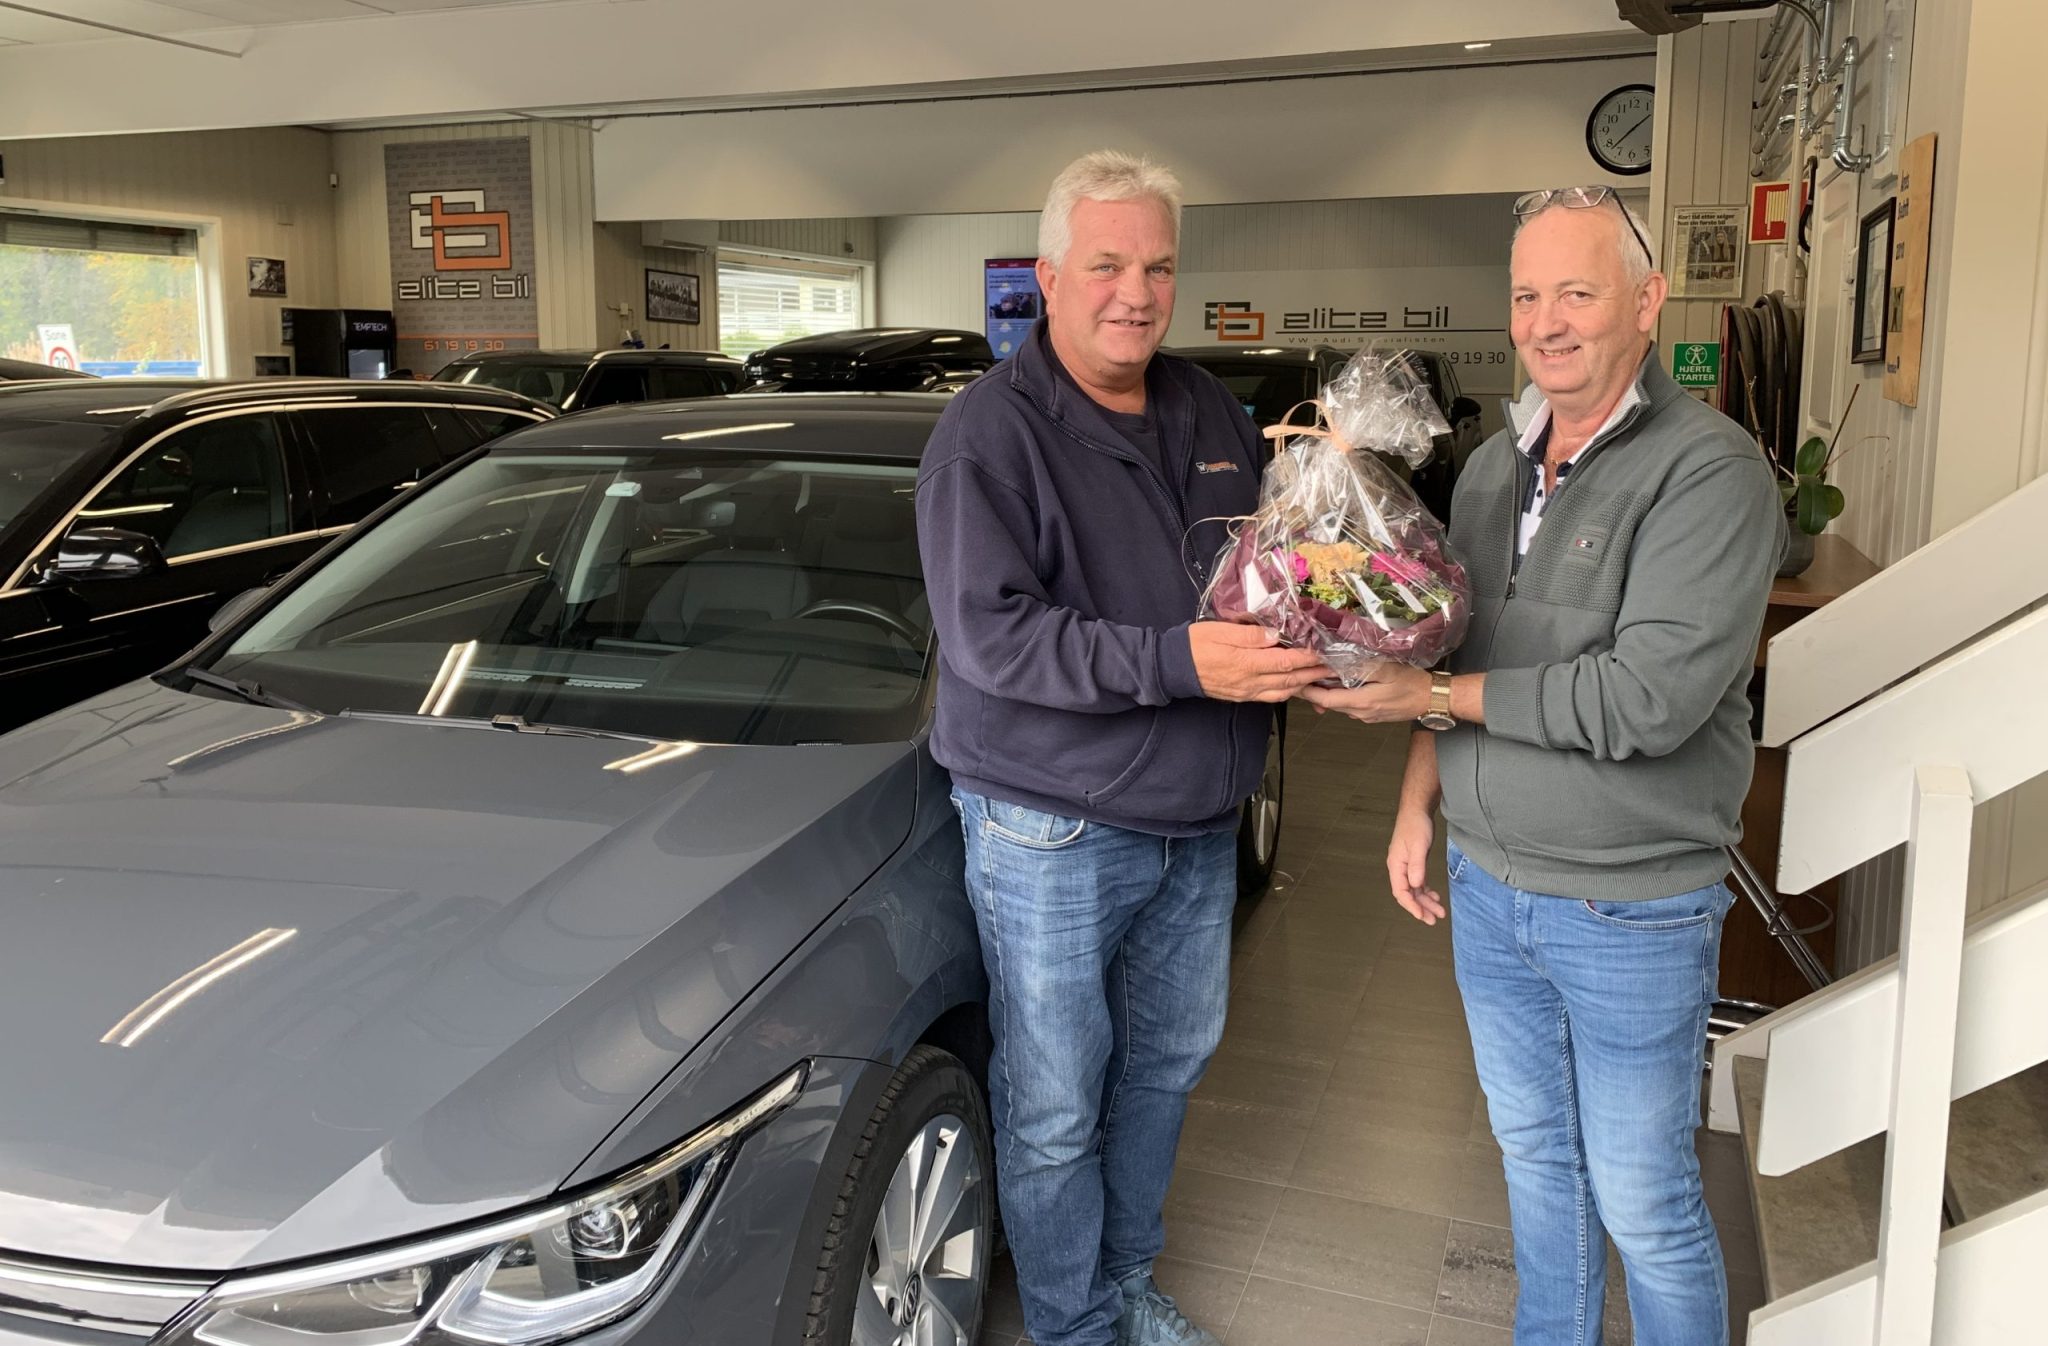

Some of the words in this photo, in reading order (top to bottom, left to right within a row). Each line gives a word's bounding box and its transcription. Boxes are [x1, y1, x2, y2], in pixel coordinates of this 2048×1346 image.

[1617, 103, 1626, 114] 11
[1629, 98, 1641, 109] 12
[1607, 114, 1619, 124] 10
[1602, 125, 1610, 136] 9
[1605, 139, 1614, 148] 8
[1617, 146, 1624, 156] 7
[1628, 150, 1636, 161] 6
[398, 276, 481, 300] elite
[492, 274, 530, 299] bil
[1283, 307, 1387, 329] elite
[1403, 305, 1449, 328] bil
[353, 322, 388, 332] TEMPTECH
[424, 340, 439, 351] 61
[445, 340, 459, 351] 19
[465, 340, 478, 351] 19
[484, 340, 505, 351] 30
[1288, 336, 1309, 344] VW
[1464, 351, 1482, 365] 19
[1487, 351, 1506, 365] 30
[1679, 365, 1713, 373] HJERTE
[1675, 373, 1715, 382] STARTER
